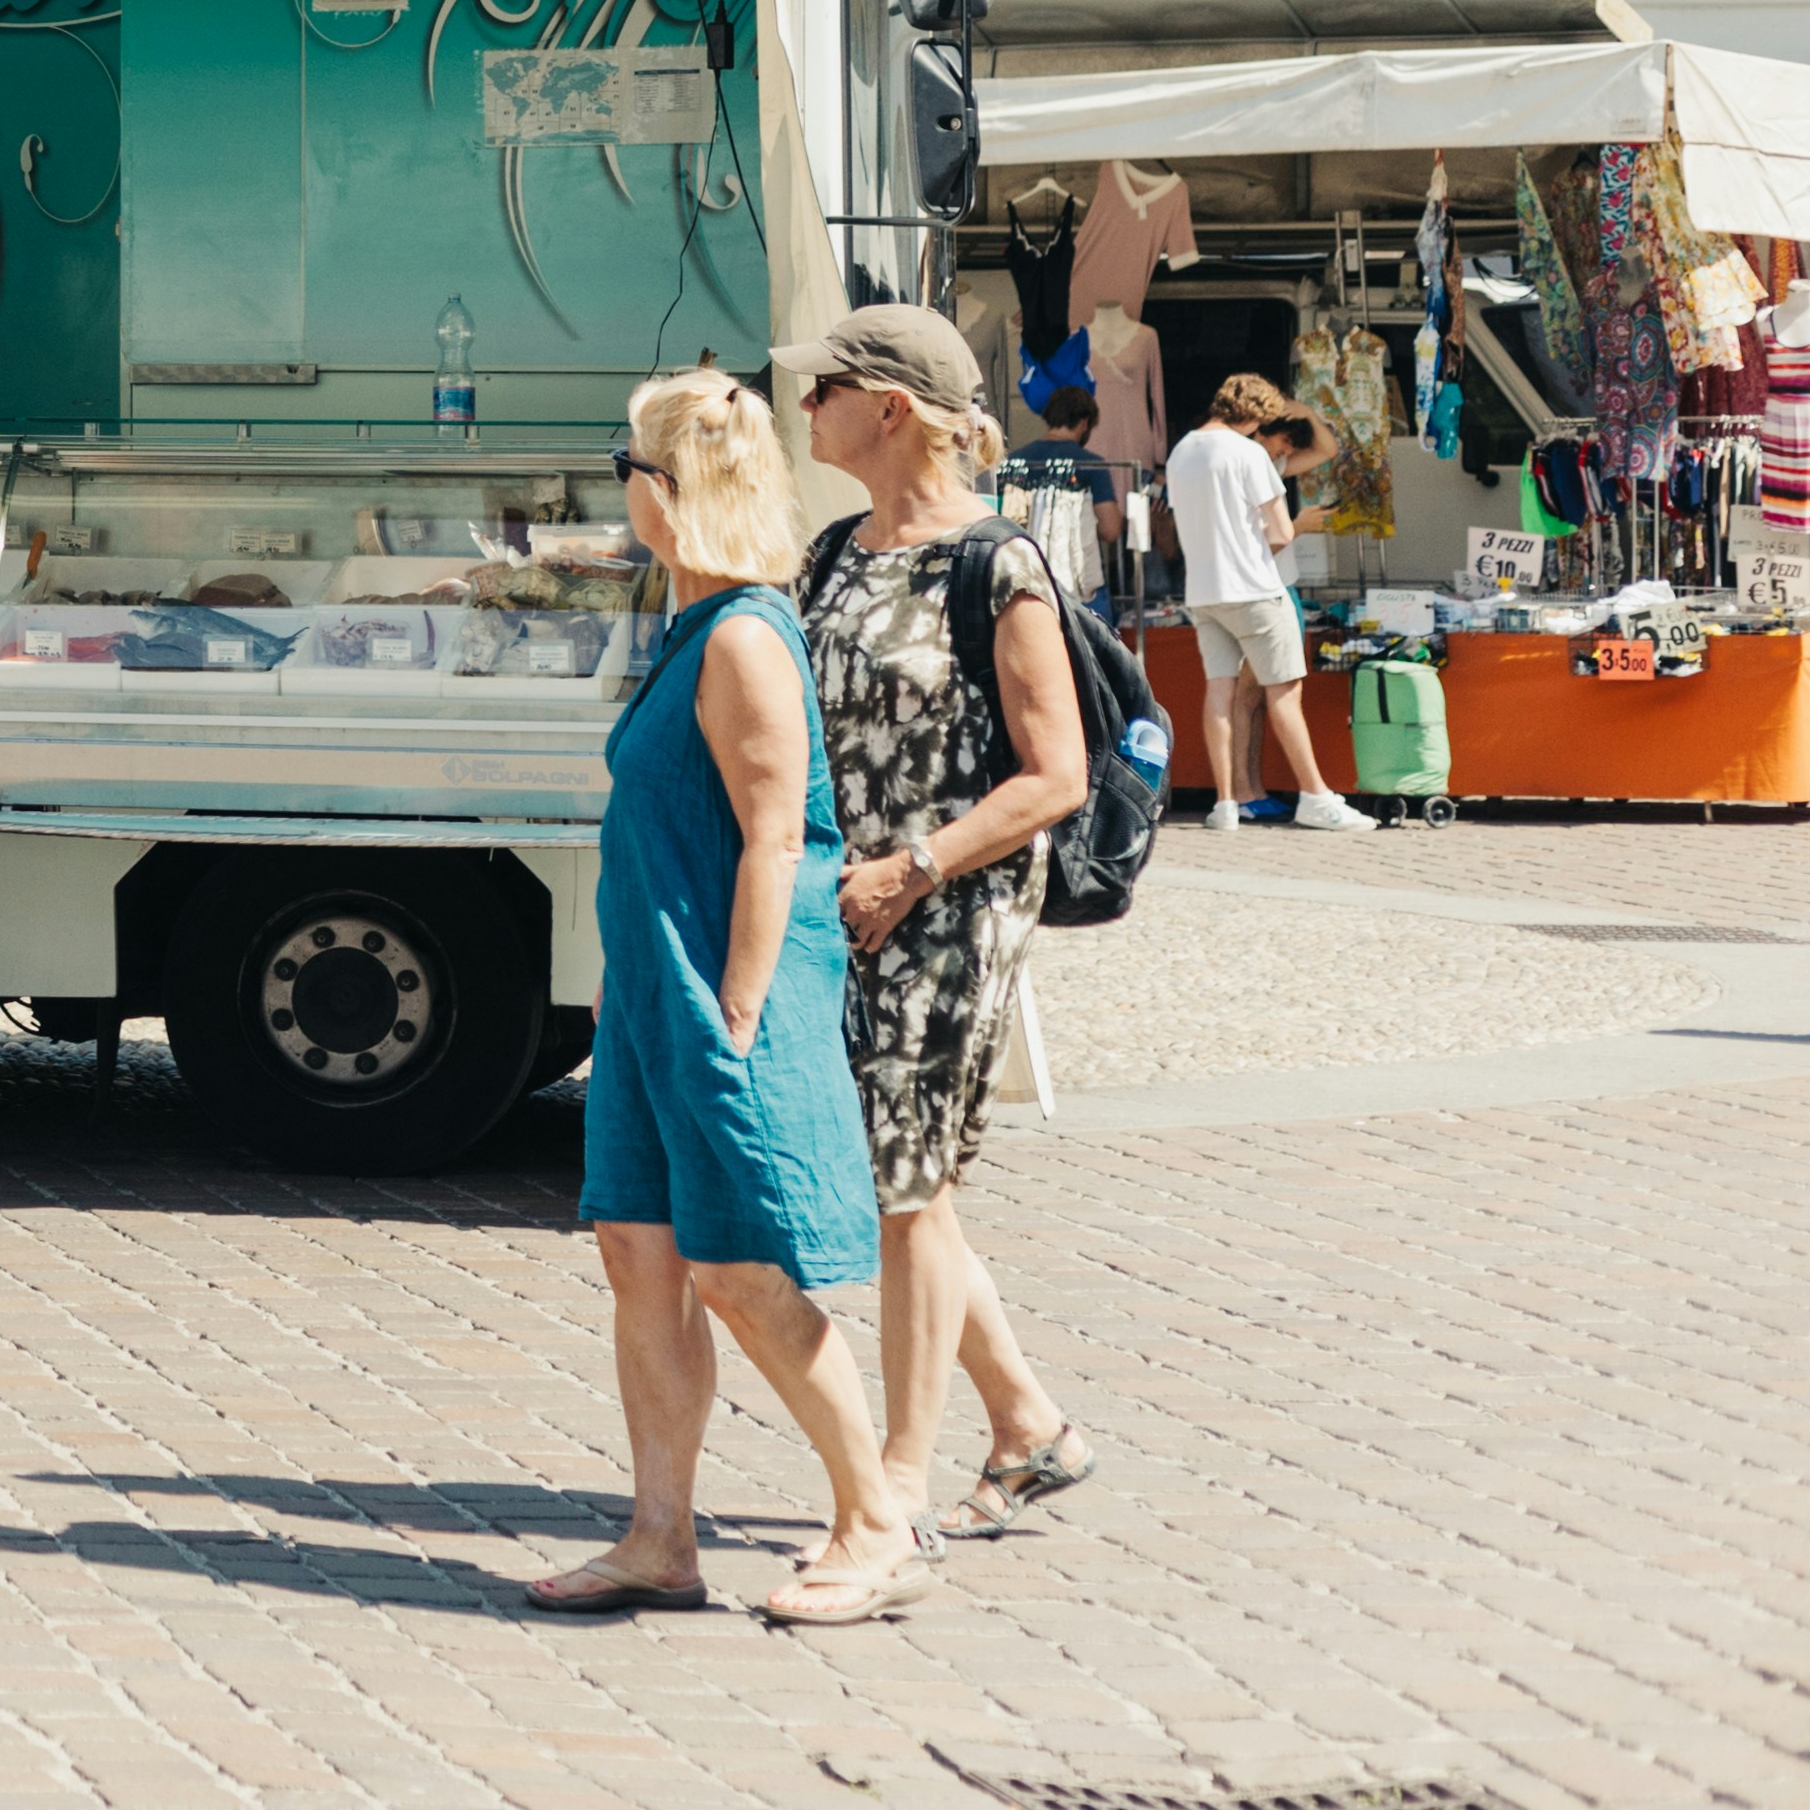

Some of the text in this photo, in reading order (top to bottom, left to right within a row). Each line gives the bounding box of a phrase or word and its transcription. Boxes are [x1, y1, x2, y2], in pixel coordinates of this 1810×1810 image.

[1481, 531, 1536, 554] 3 PEZZI
[1752, 557, 1803, 578] 3 PEZZI
[472, 768, 590, 786] BOLPAGNI
